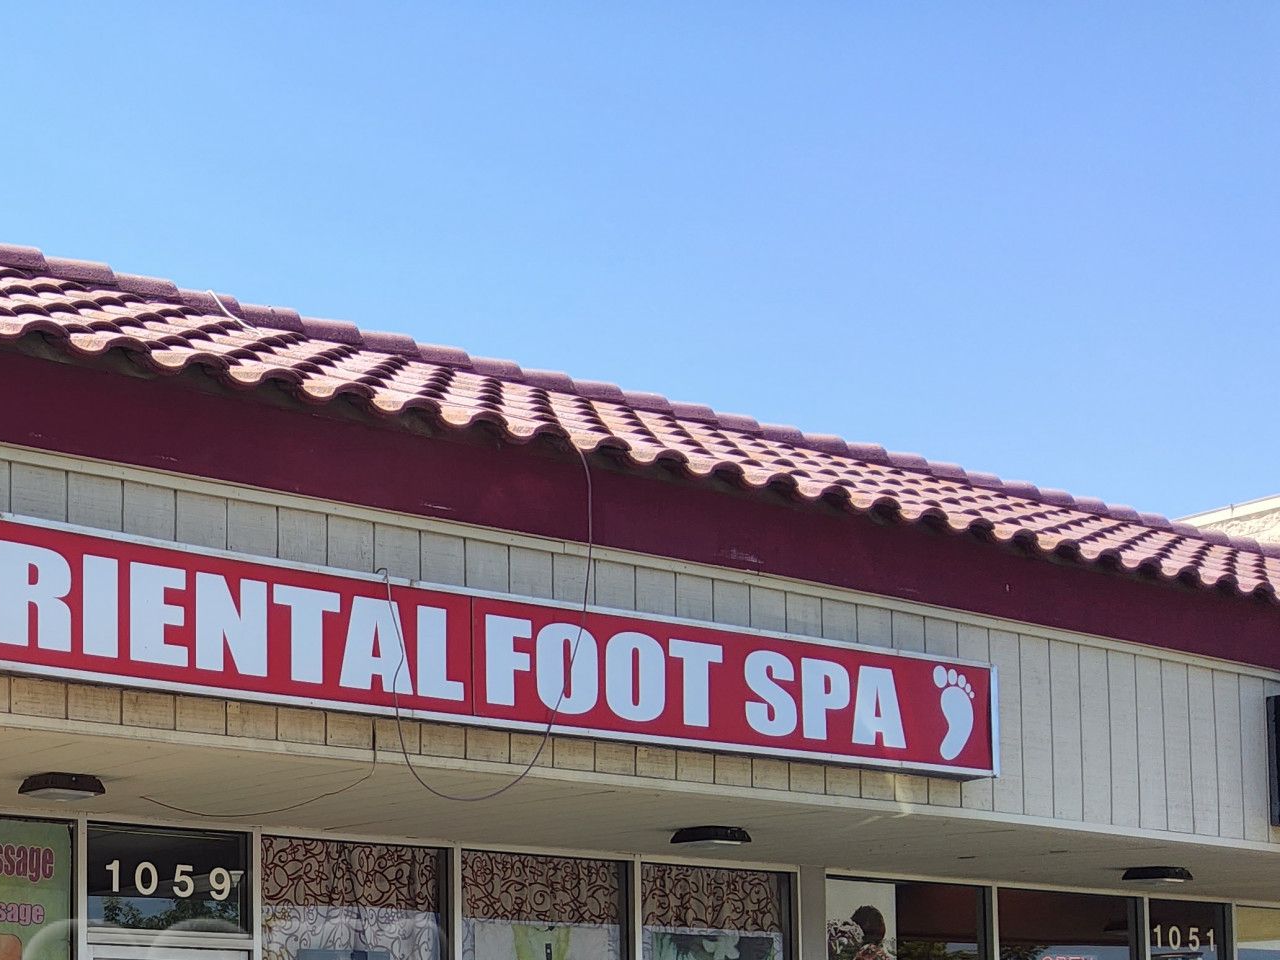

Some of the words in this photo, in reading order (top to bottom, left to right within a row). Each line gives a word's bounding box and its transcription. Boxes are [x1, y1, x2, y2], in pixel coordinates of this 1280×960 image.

[484, 614, 723, 728] FOOT
[744, 650, 907, 749] SPA
[105, 859, 231, 900] 1059
[1153, 924, 1217, 951] 1051
